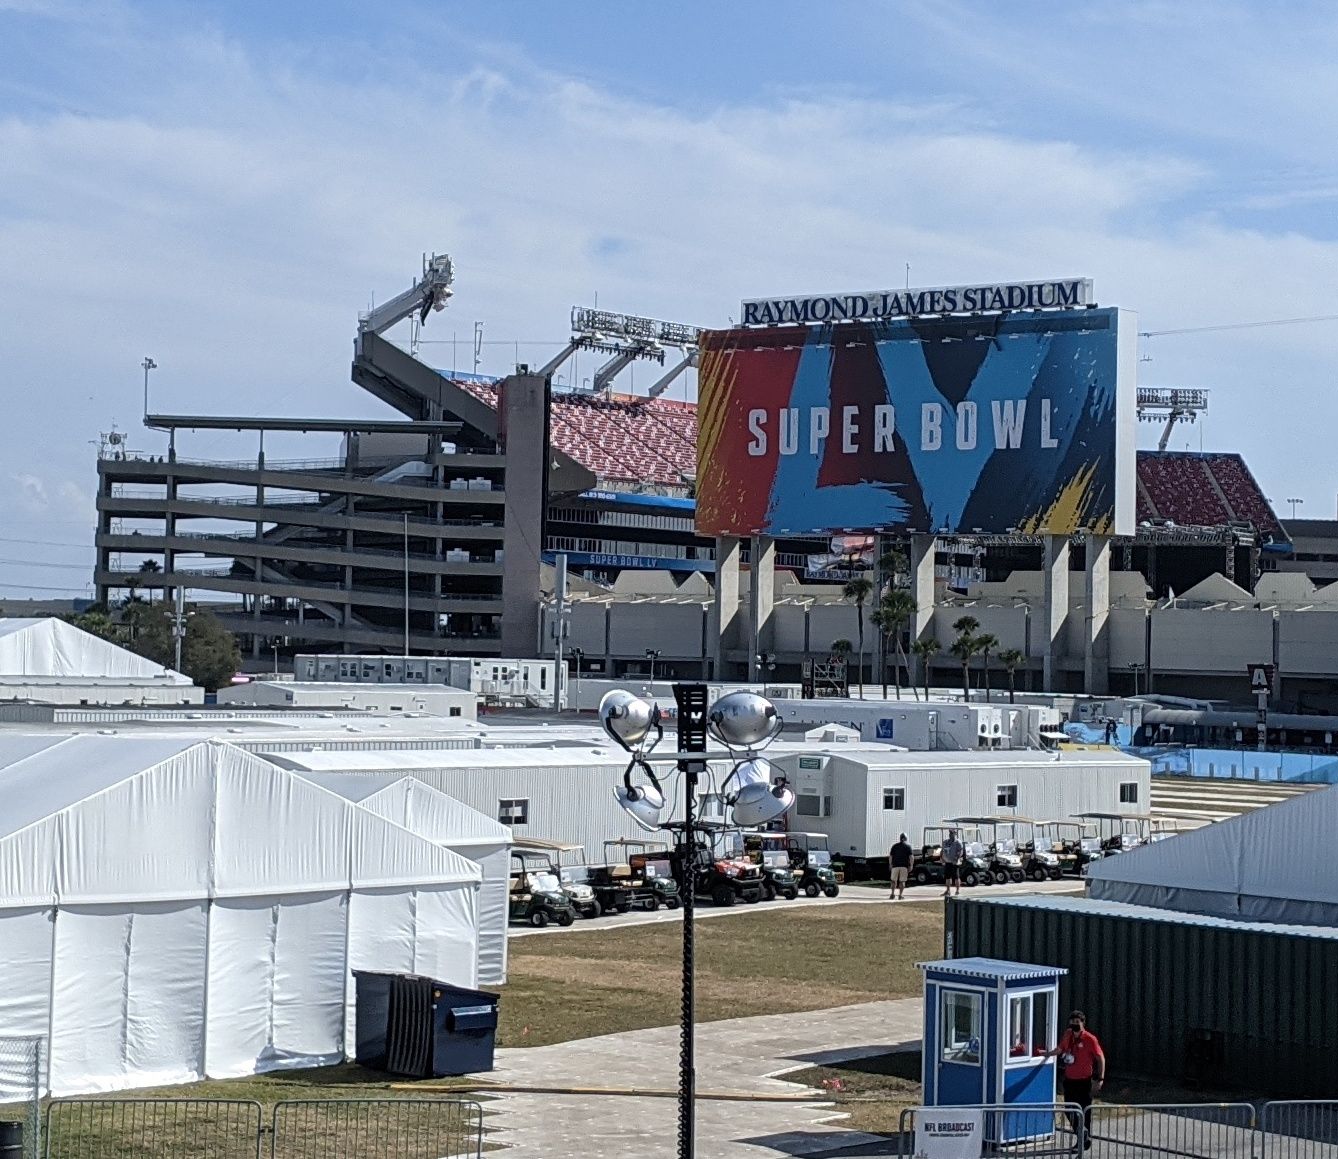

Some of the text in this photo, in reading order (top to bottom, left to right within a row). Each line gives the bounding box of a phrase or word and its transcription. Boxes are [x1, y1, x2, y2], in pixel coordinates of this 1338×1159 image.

[744, 281, 1081, 325] RAYMOND JAMES STADIUM
[747, 399, 1059, 456] SUPER BOWL
[590, 555, 617, 566] SUPER
[620, 556, 644, 567] BOWL
[1252, 668, 1268, 686] A
[924, 1122, 975, 1133] NFL BROADCAST
